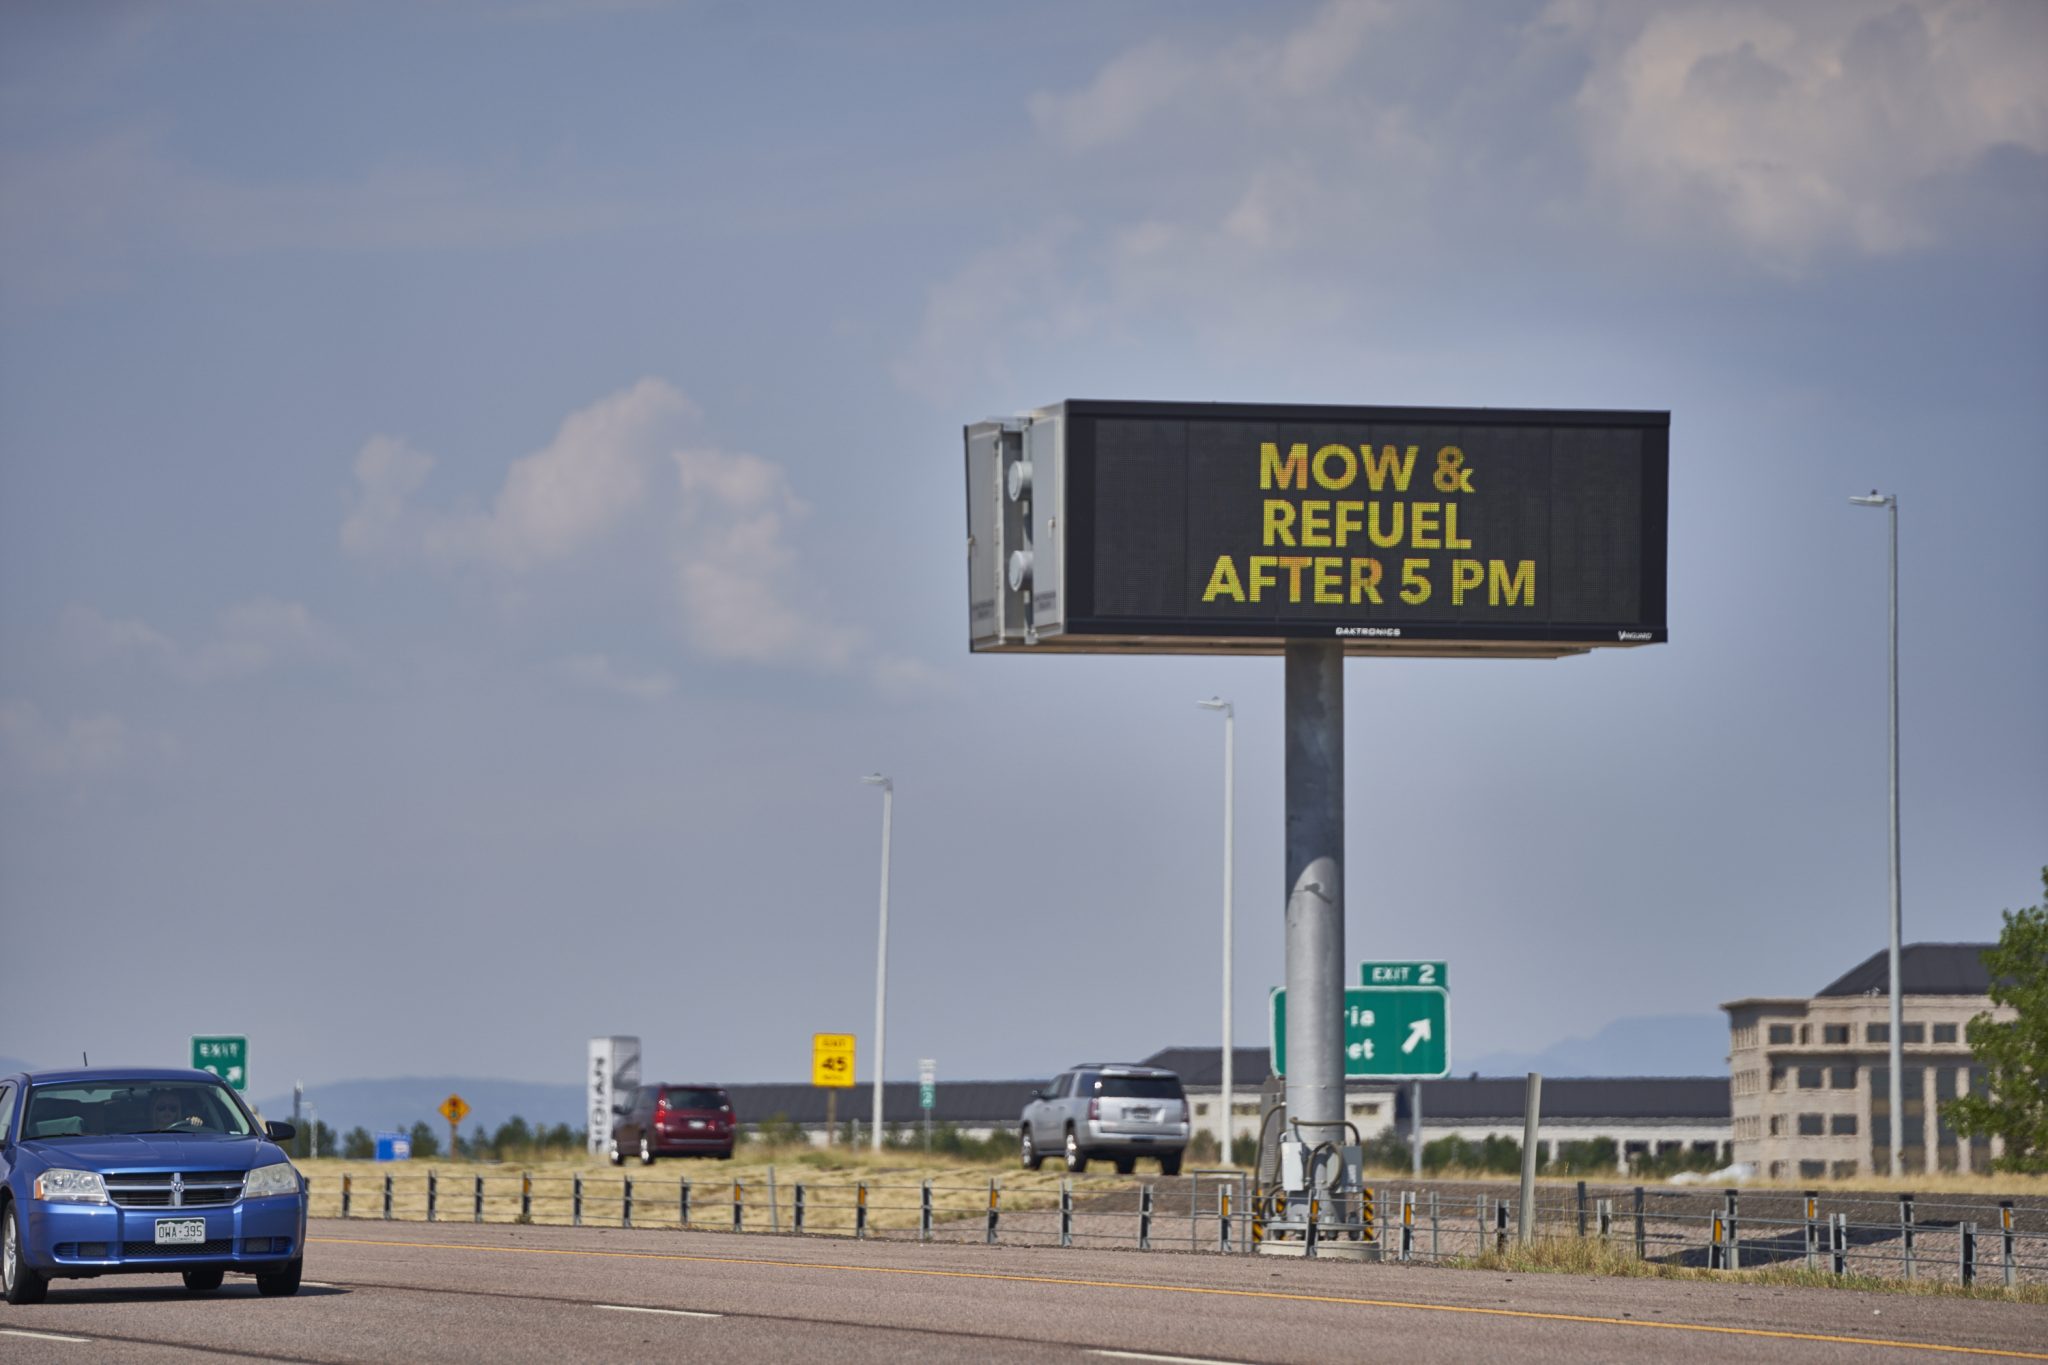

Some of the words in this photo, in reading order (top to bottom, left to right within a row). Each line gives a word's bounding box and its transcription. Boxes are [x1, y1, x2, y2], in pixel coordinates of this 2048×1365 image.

[1259, 442, 1420, 492] MOW
[1432, 446, 1476, 493] &
[1262, 499, 1472, 549] REFUEL
[1201, 555, 1384, 605] AFTER
[1399, 558, 1432, 605] 5
[1451, 558, 1536, 607] PM
[1335, 627, 1401, 637] DAKTRONICS
[1372, 967, 1411, 982] EXIT
[1418, 964, 1436, 984] 2
[200, 1043, 239, 1058] EXIT
[1345, 1038, 1375, 1060] et
[822, 1056, 849, 1073] 45
